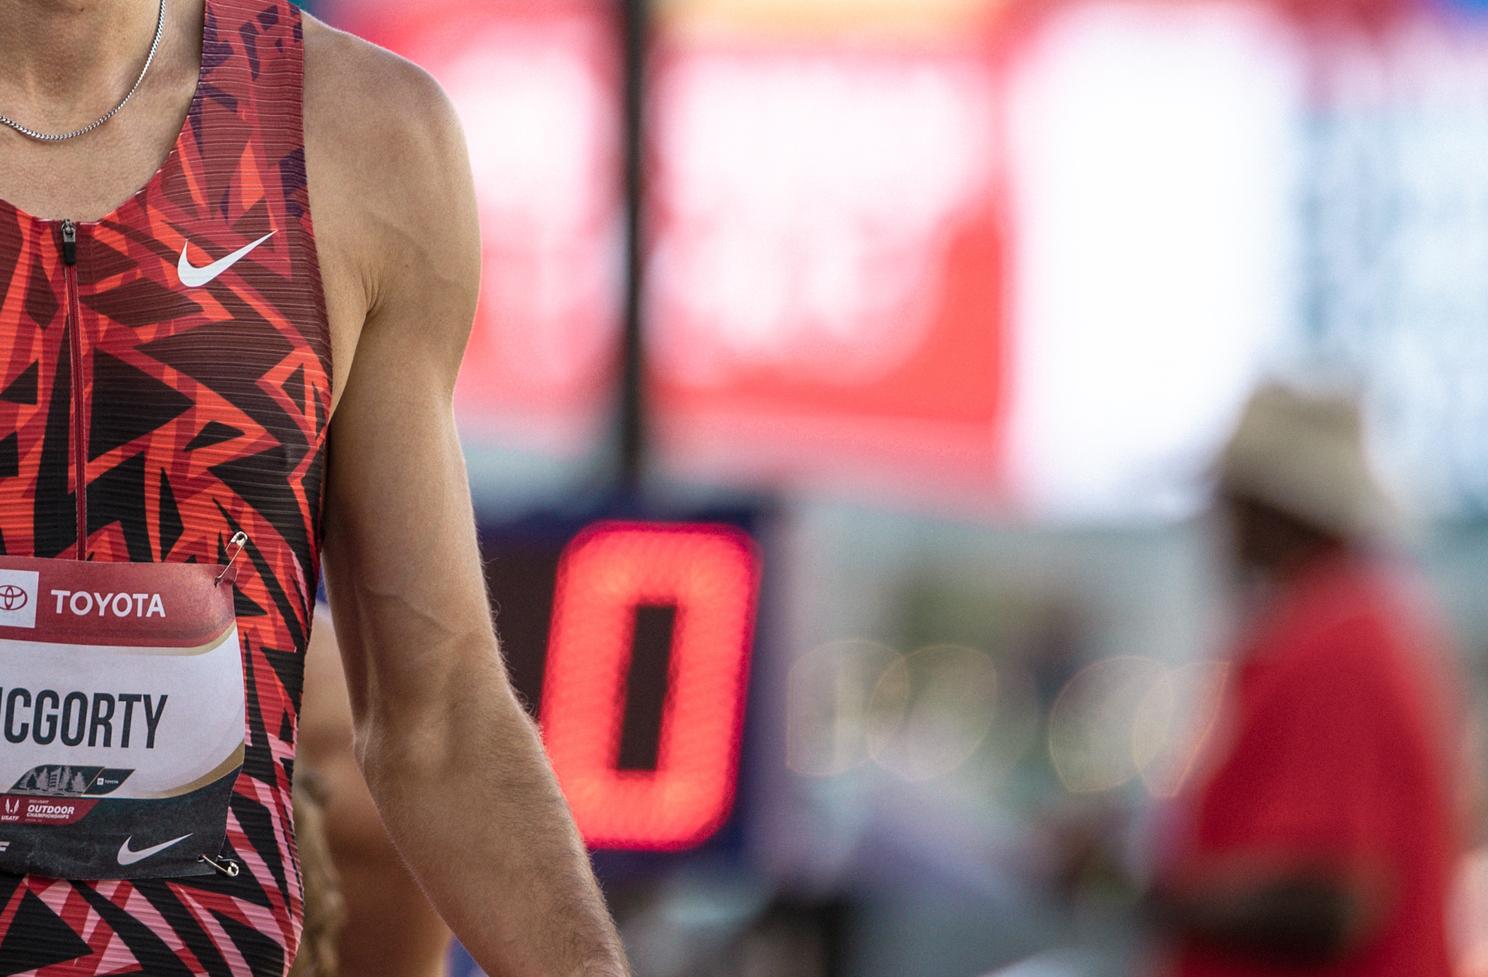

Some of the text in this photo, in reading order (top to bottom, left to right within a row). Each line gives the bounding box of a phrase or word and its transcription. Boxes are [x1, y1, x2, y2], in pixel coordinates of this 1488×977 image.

[50, 589, 166, 618] TOYOTA
[539, 520, 763, 852] 0
[26, 812, 69, 820] CHAMPIONSHIPS
[27, 804, 75, 815] OUTDOOR
